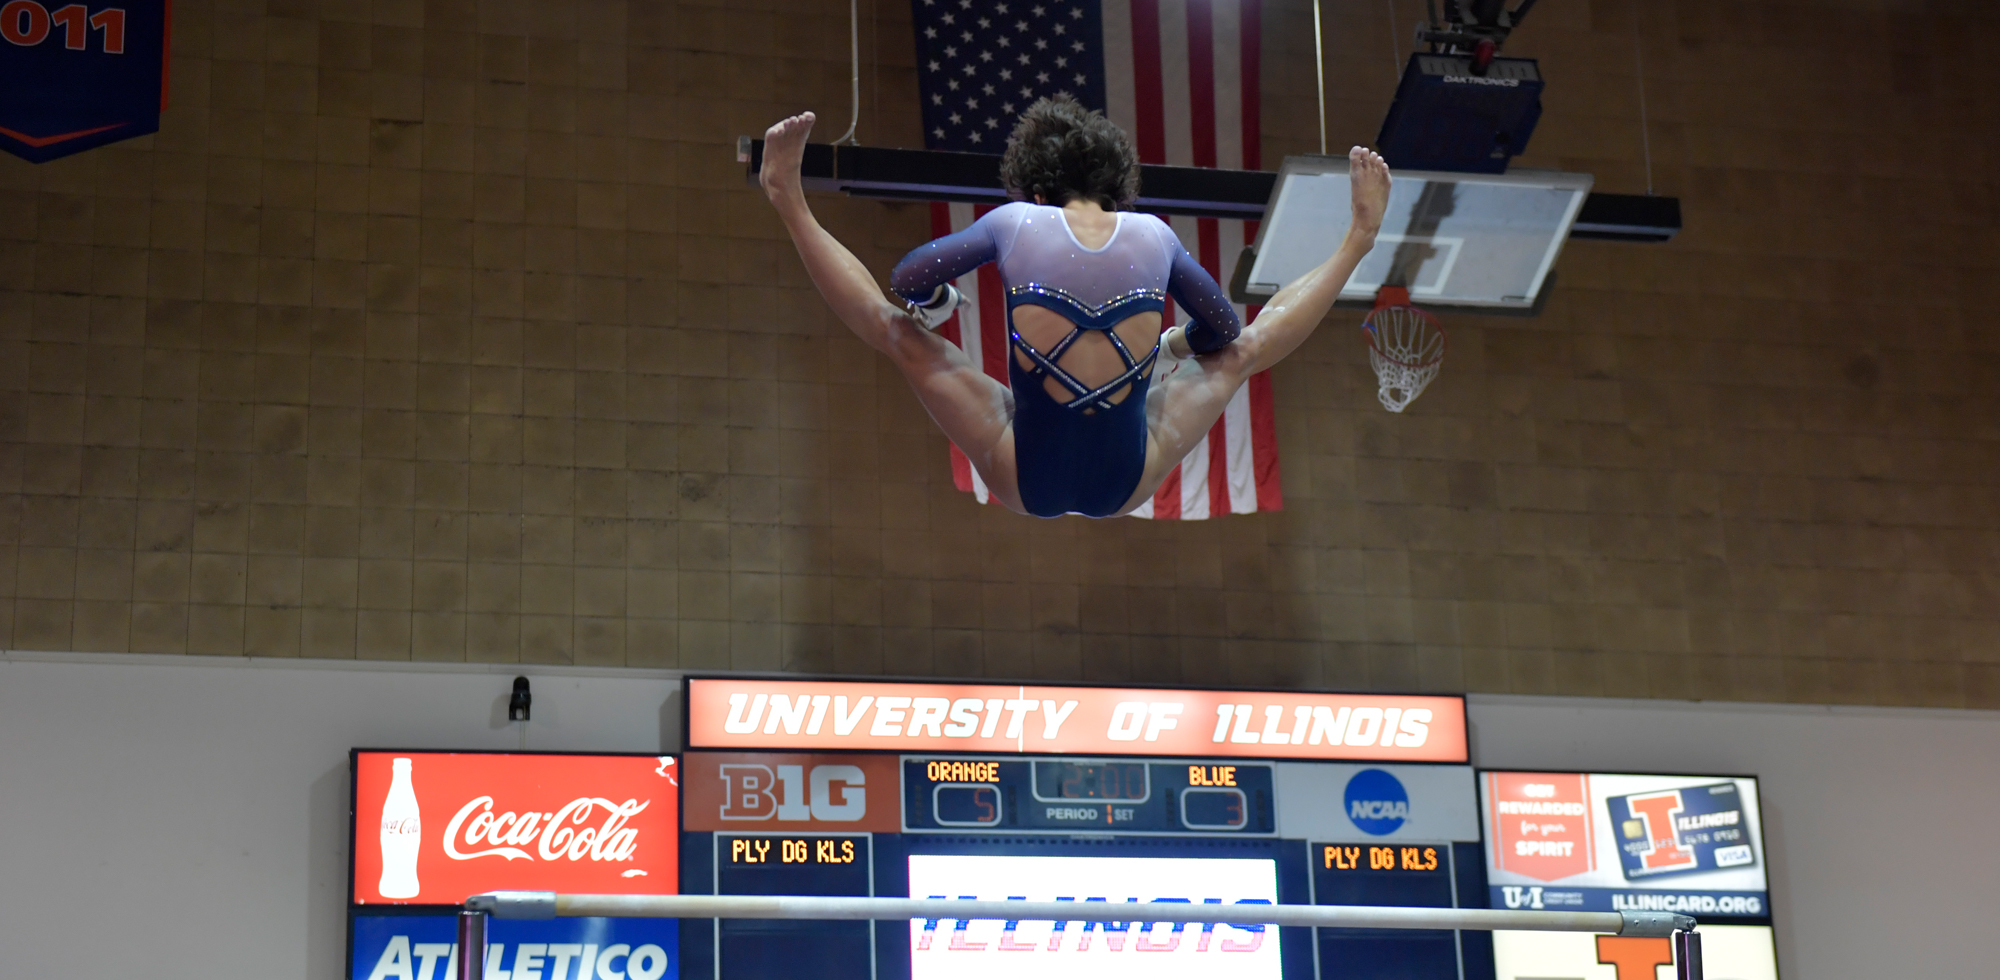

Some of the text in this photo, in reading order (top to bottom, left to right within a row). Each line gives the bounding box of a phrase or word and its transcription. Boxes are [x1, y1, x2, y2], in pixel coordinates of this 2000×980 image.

[1443, 75, 1519, 87] DAKTRONICS
[724, 693, 1433, 748] UNIVERSITY OF ILLINOIS
[927, 760, 1000, 783] ORANGE
[1188, 765, 1238, 787] BLUE
[974, 788, 995, 823] 5
[1046, 807, 1098, 821] PERIOD
[1114, 808, 1134, 821] SET
[1226, 792, 1244, 826] 3
[1350, 800, 1409, 820] NCAA
[1499, 801, 1585, 816] REWARDED
[443, 795, 651, 862] Coca-Cola
[1520, 820, 1566, 836] for your
[1678, 810, 1739, 831] ILLINOIS
[732, 839, 855, 863] PLY DG KLS
[1324, 846, 1438, 871] PLY DG KLS
[1515, 840, 1574, 857] SPIRIT
[1612, 894, 1762, 914] ILLINICARD.ORG
[916, 895, 1273, 952] ILLINOIS
